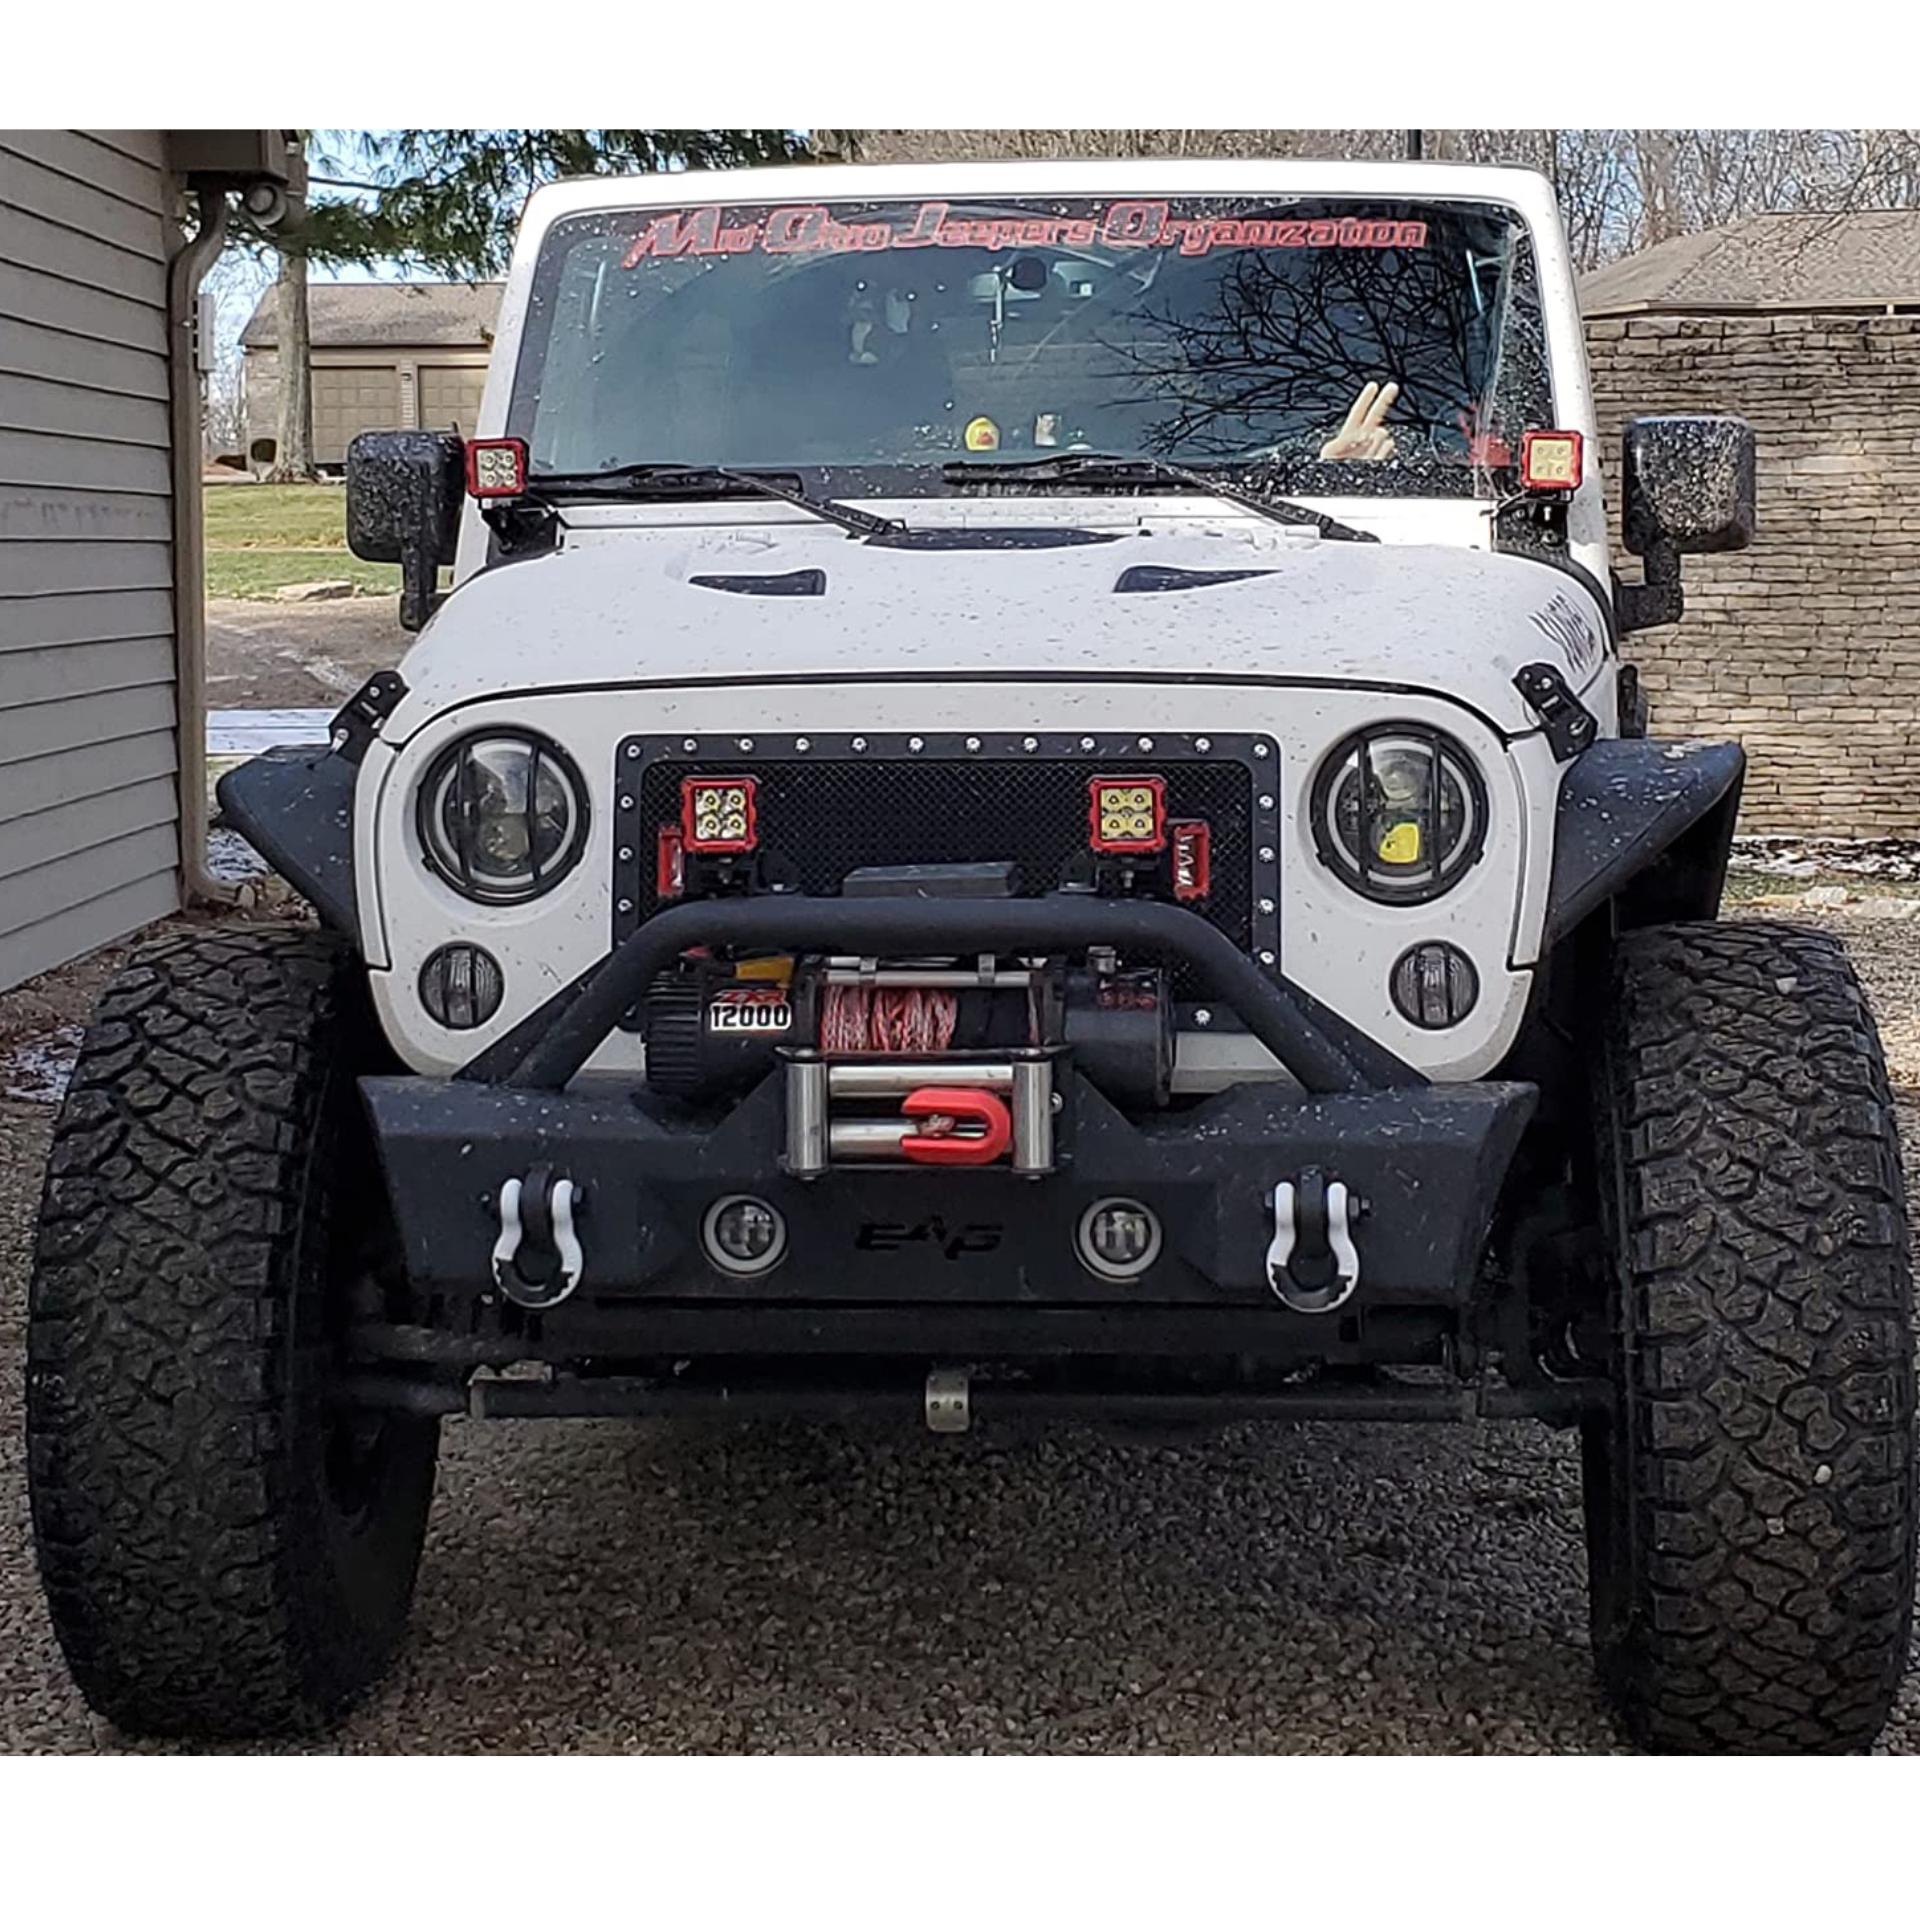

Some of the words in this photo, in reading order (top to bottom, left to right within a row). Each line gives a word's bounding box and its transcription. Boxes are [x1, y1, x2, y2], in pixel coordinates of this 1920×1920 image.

[892, 202, 1096, 250] Jeepers
[1101, 201, 1427, 256] Organization
[711, 1004, 789, 1028] 12000
